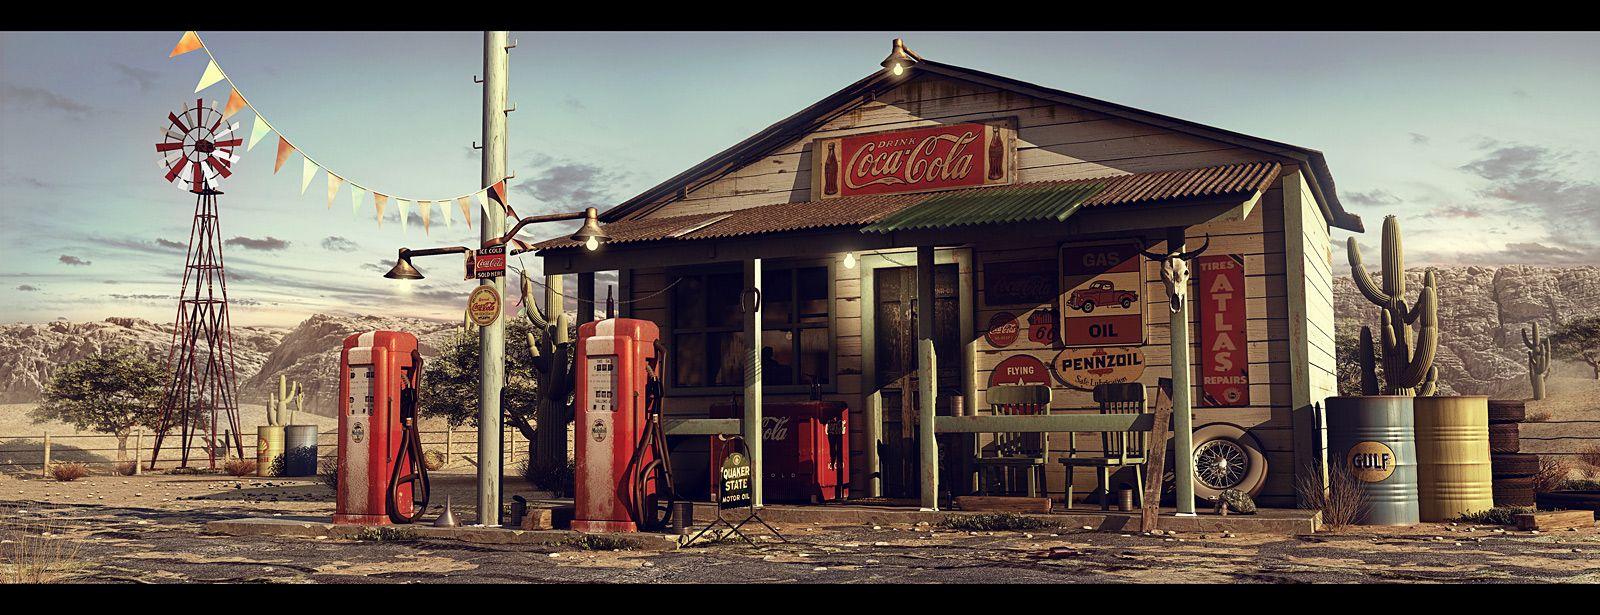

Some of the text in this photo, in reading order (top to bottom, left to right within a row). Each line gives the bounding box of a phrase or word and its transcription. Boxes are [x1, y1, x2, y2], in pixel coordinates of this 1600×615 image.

[877, 136, 917, 149] DRINK
[845, 129, 982, 189] Coca-Cola
[1082, 251, 1120, 267] GAS
[1200, 261, 1235, 271] TIRES
[1088, 324, 1119, 338] OIL
[1062, 353, 1142, 372] PENNZOIL
[1007, 366, 1034, 376] FLYING
[1204, 375, 1247, 385] REPAIRS
[1353, 453, 1391, 471] GULF
[723, 465, 750, 480] QUAKER
[725, 478, 748, 491] STATE
[722, 494, 741, 503] MOTOR
